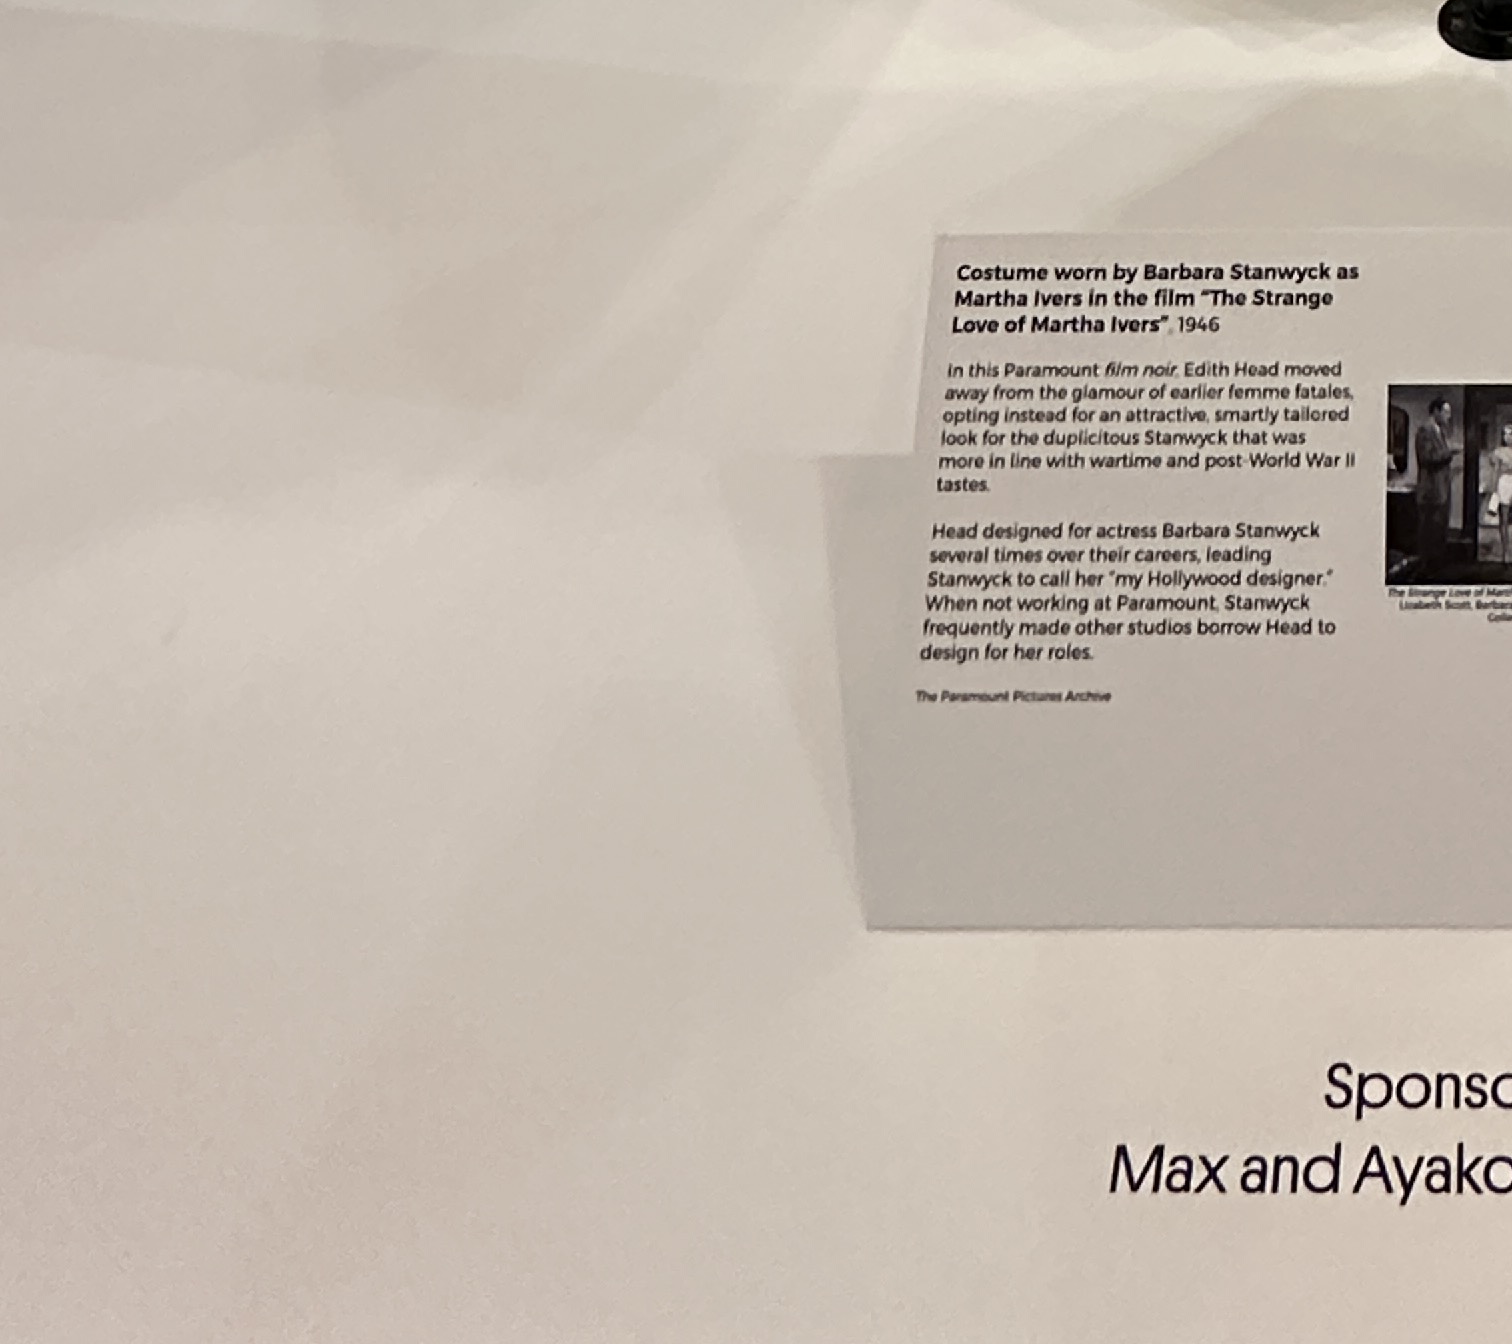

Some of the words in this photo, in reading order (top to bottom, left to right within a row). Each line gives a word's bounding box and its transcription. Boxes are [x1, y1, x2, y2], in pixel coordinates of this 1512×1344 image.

[956, 265, 1049, 281] Costume
[1054, 267, 1107, 281] worn
[1112, 263, 1139, 284] by
[1143, 263, 1224, 280] Barbara
[1229, 263, 1331, 284] Stanwyck
[1336, 267, 1360, 279] as
[954, 289, 1028, 307] Martha
[1034, 290, 1083, 307] Ivers
[1088, 289, 1108, 307] in
[1113, 289, 1148, 307] the
[1154, 289, 1196, 307] film
[1251, 289, 1334, 310] Strange
[952, 317, 1000, 333] Love
[1004, 315, 1027, 333] of
[1030, 315, 1106, 333] Martha
[1177, 317, 1220, 333] 1946
[947, 363, 964, 377] In
[968, 363, 1000, 377] this
[1004, 363, 1100, 377] Paramount
[1104, 361, 1140, 377] film
[1183, 361, 1230, 377] Edith
[1234, 361, 1280, 377] Head
[1284, 361, 1342, 377] moved
[944, 389, 990, 403] away
[993, 384, 1034, 400] from
[1039, 385, 1068, 400] the
[1071, 385, 1146, 403] glamour
[1148, 383, 1168, 399] of
[1169, 383, 1225, 399] earlier
[1228, 383, 1291, 399] femme
[942, 407, 1000, 426] opting
[1004, 407, 1068, 423] instead
[1072, 407, 1096, 423] for
[1098, 411, 1122, 422] an
[1214, 406, 1280, 425] smartly
[1283, 405, 1350, 421] tailored
[940, 430, 978, 445] look
[982, 429, 1006, 445] for
[1010, 429, 1040, 445] the
[1042, 429, 1140, 449] duplicitous
[1144, 429, 1228, 449] Stanwyck
[1232, 429, 1268, 445] that
[1272, 433, 1307, 445] was
[938, 457, 985, 469] more
[988, 453, 1006, 469] in
[1010, 453, 1042, 469] line
[1046, 453, 1086, 469] with
[1088, 453, 1163, 468] wartime
[1166, 452, 1200, 468] and
[1204, 451, 1302, 471] post-World
[1305, 453, 1342, 468] War
[1345, 453, 1356, 467] II
[1109, 1144, 1229, 1193] Max
[1241, 1141, 1341, 1194] and
